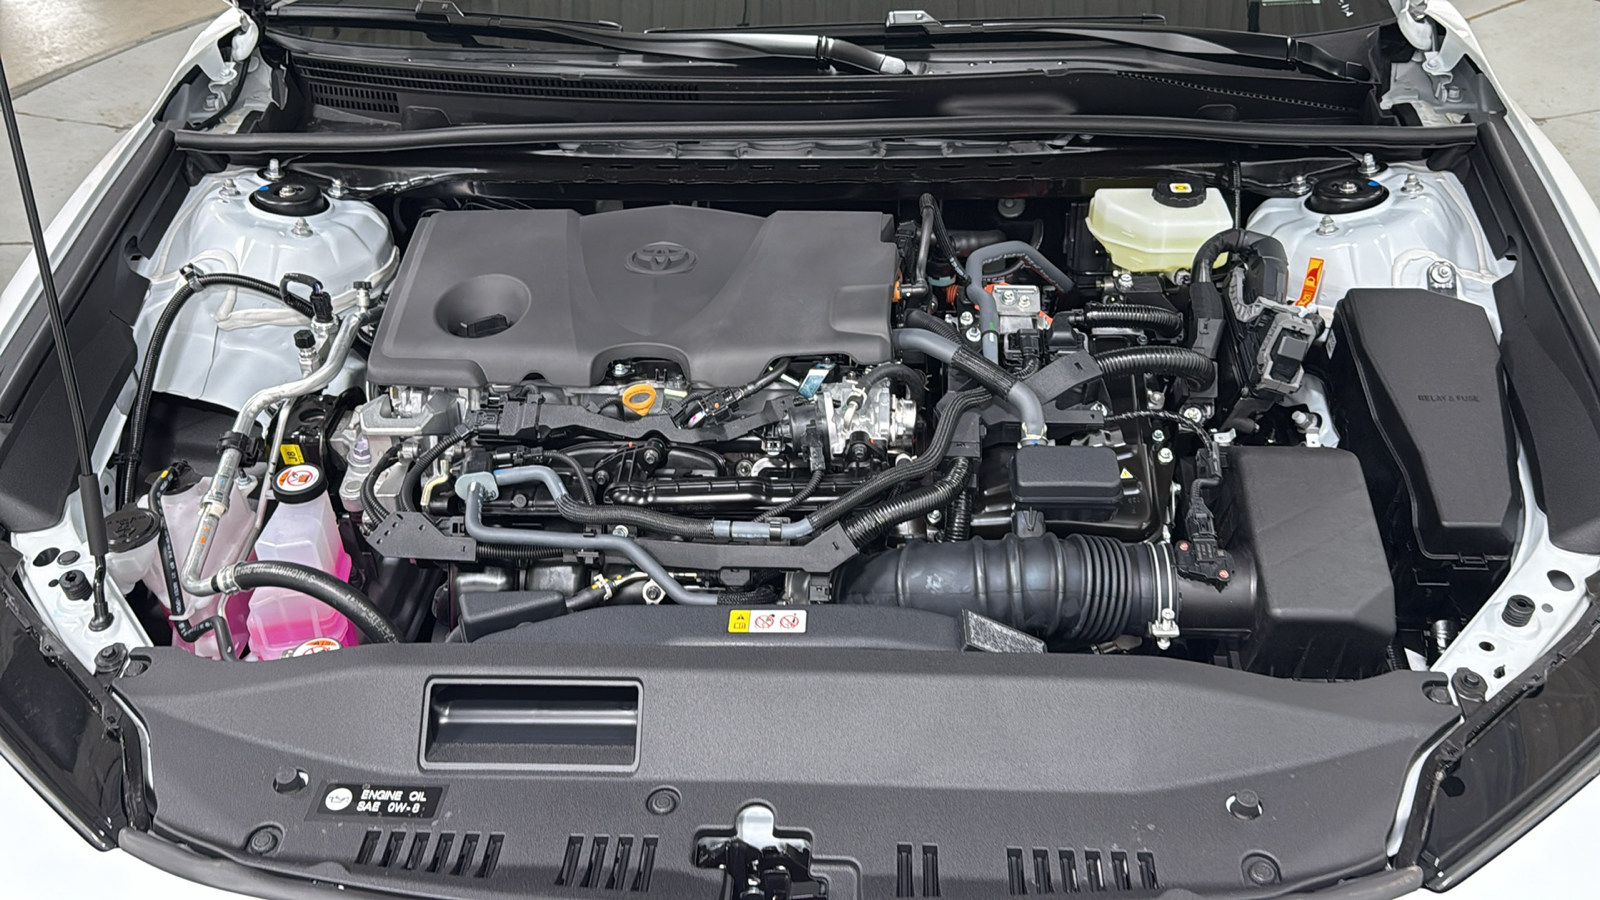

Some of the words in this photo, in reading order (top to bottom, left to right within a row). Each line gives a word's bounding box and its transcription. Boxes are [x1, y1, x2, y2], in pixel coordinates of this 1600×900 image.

[361, 789, 403, 801] ENGINE
[409, 791, 427, 802] OIL
[356, 801, 381, 812] SAE
